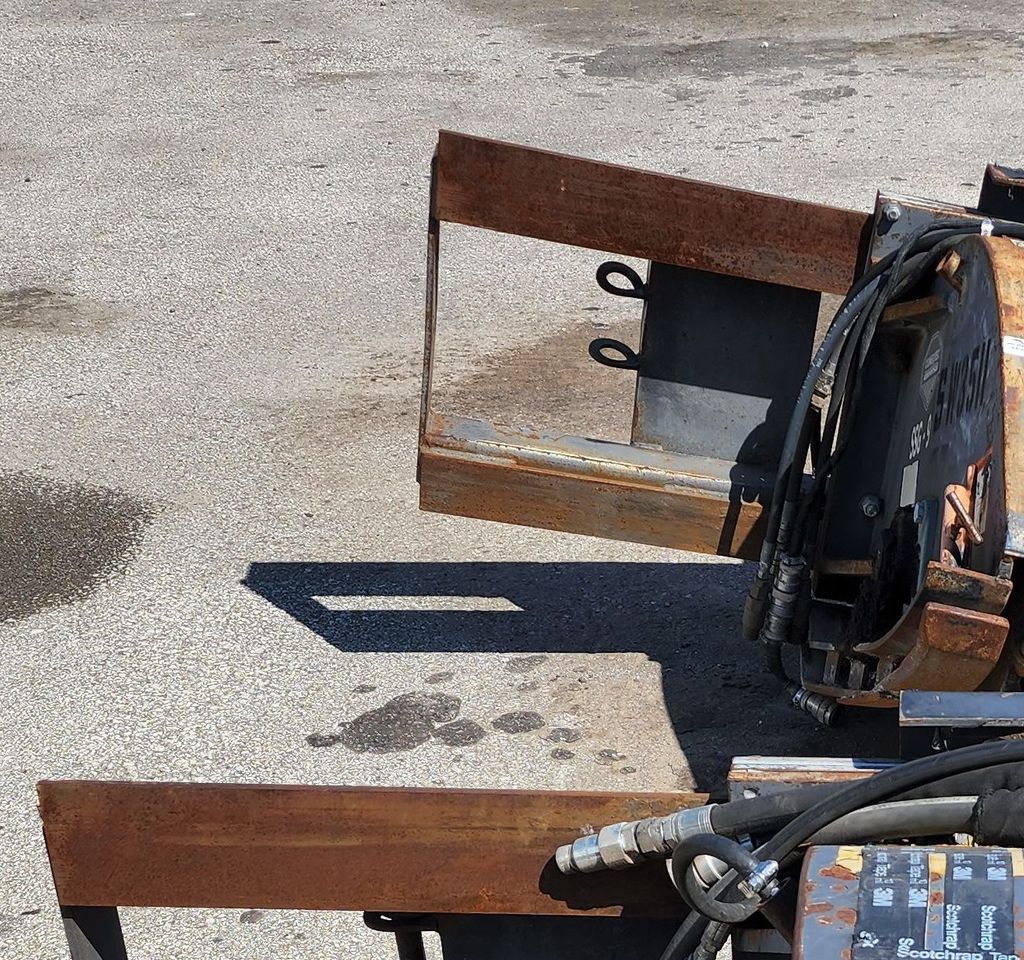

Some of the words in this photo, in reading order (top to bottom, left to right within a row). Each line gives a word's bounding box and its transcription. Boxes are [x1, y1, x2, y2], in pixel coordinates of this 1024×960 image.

[953, 866, 973, 881] 3M
[987, 866, 1007, 881] 3M
[872, 887, 894, 907] 3M
[908, 887, 928, 908] 3M
[943, 903, 961, 950] Scotchrap
[978, 904, 997, 951] Scotchrap
